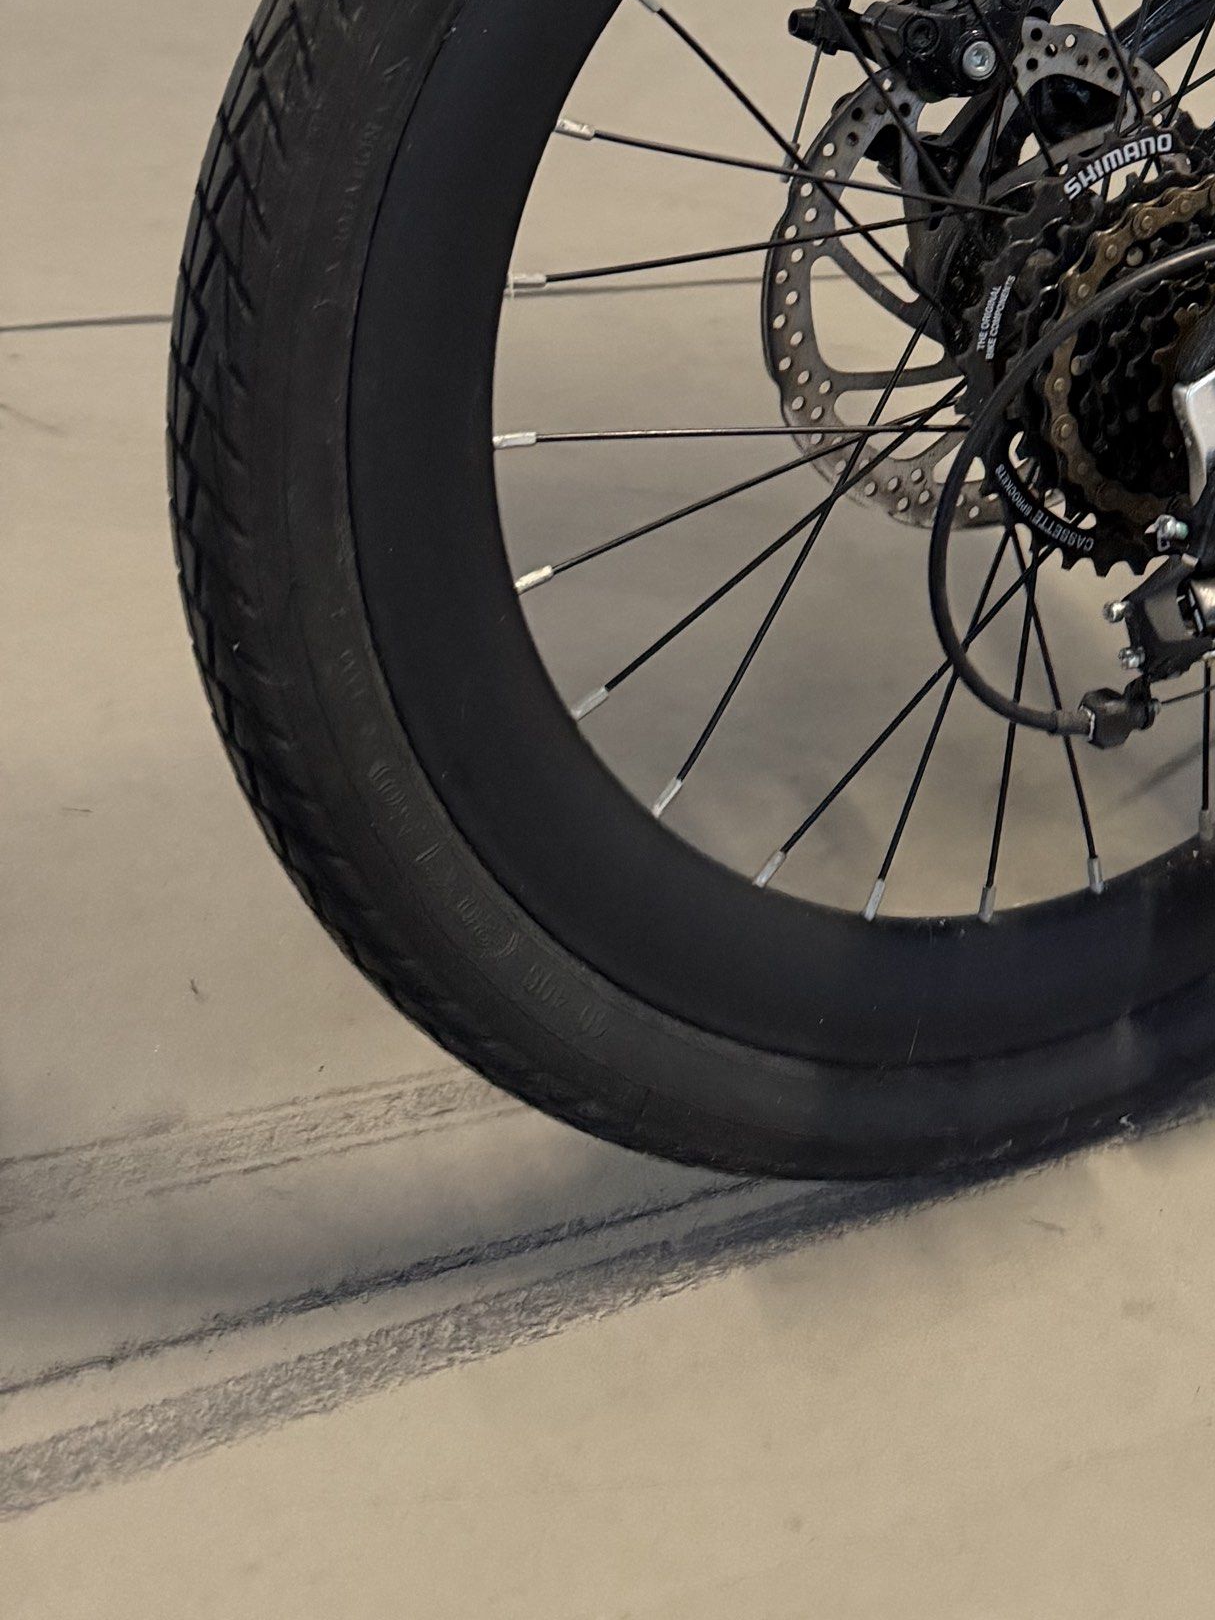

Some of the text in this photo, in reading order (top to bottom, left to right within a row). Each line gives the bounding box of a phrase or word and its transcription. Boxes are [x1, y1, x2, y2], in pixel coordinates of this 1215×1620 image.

[1063, 132, 1172, 201] SHIMANO
[994, 463, 1095, 552] CASSETTE SPROCKETS
